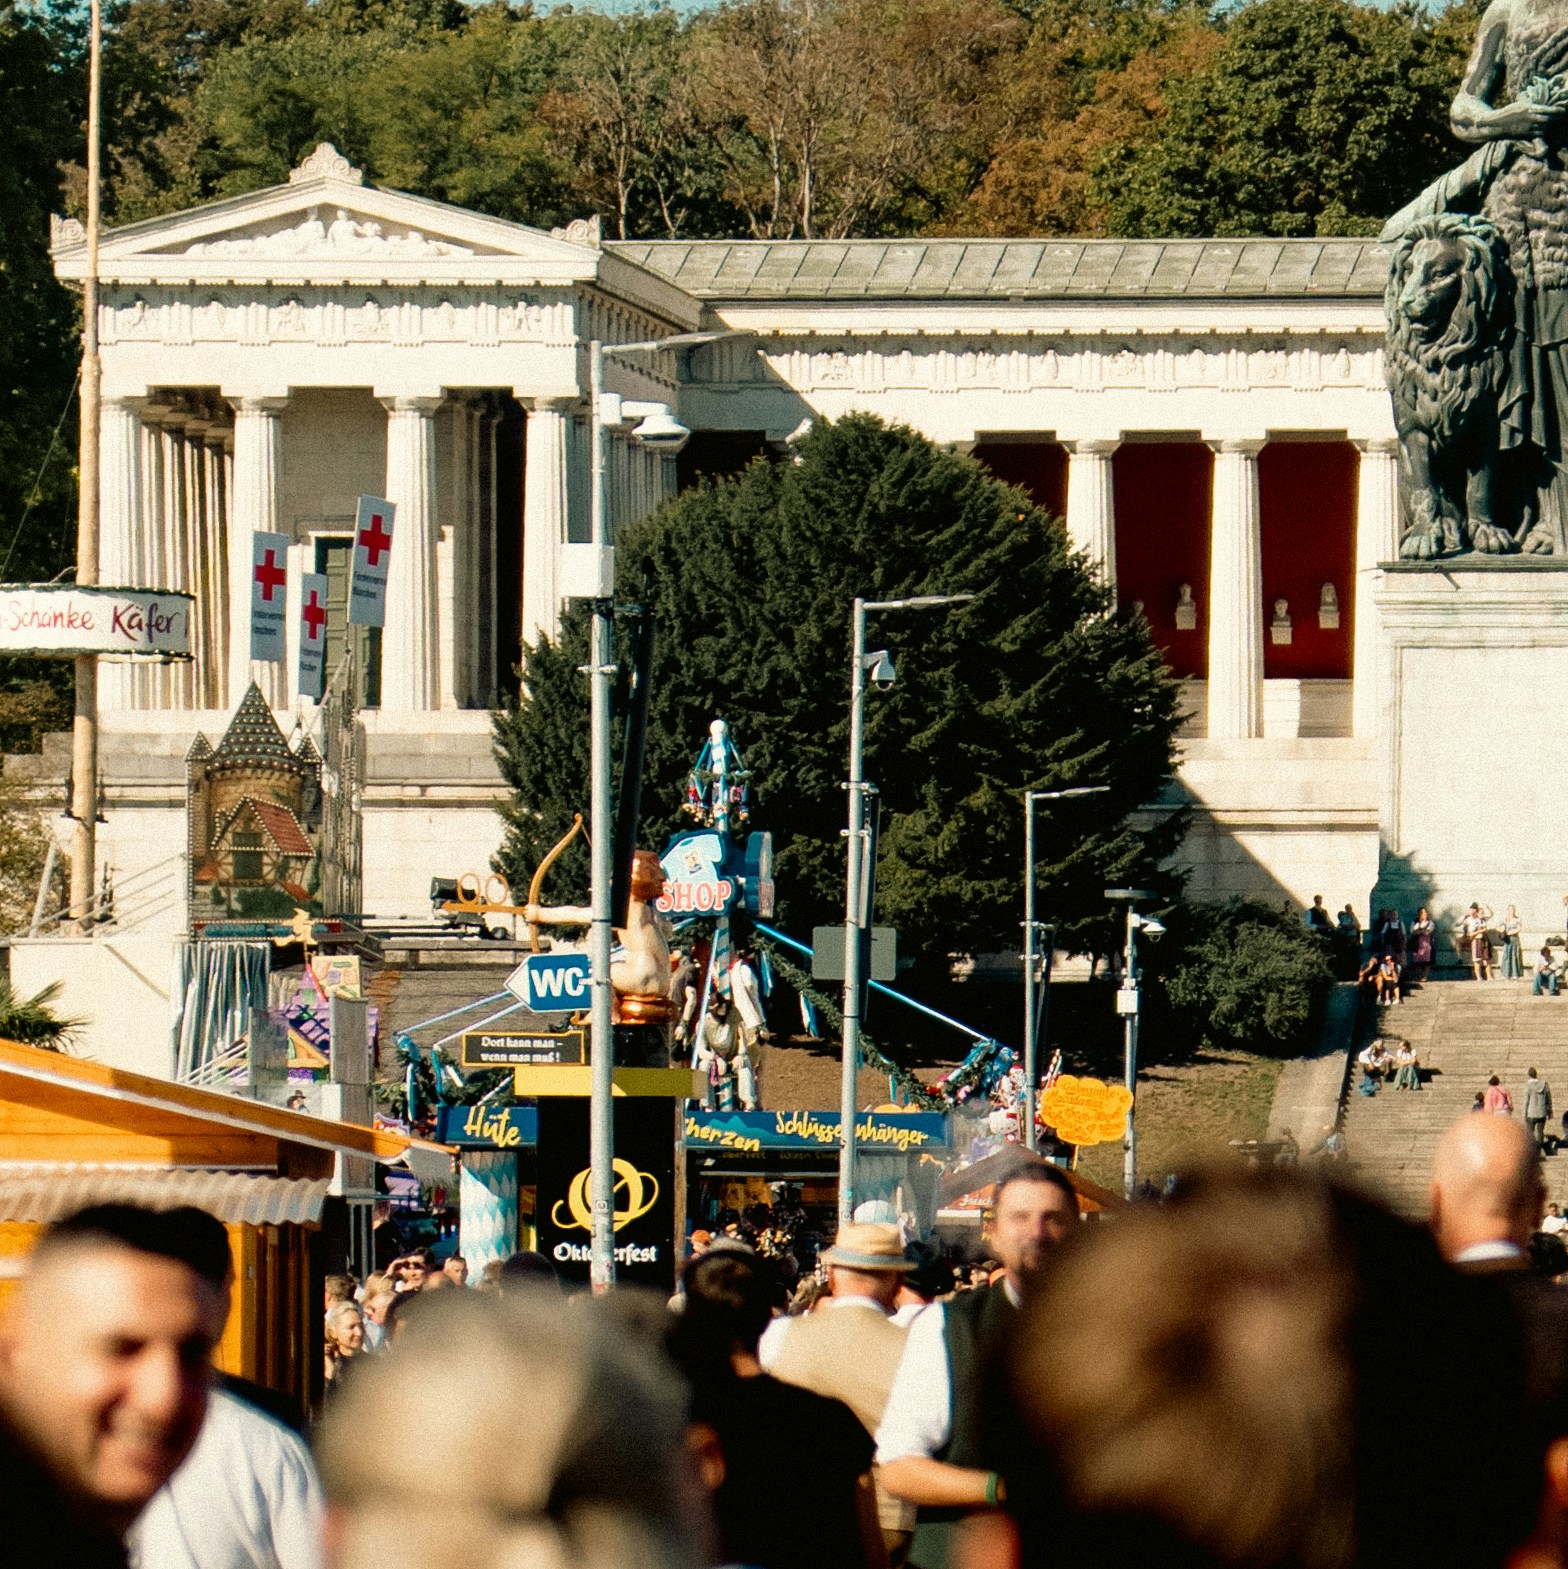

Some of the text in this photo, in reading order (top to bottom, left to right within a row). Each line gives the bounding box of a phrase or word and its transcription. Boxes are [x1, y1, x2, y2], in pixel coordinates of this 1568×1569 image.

[111, 602, 181, 643] Käfer
[656, 880, 732, 912] SHOP
[531, 967, 585, 998] WC
[480, 1053, 507, 1062] wenn
[508, 1053, 531, 1062] man
[481, 1036, 505, 1047] Dort
[532, 1039, 555, 1049] man
[463, 1105, 521, 1148] Hüte
[685, 1111, 928, 1152] herzen Schlüssenhänger
